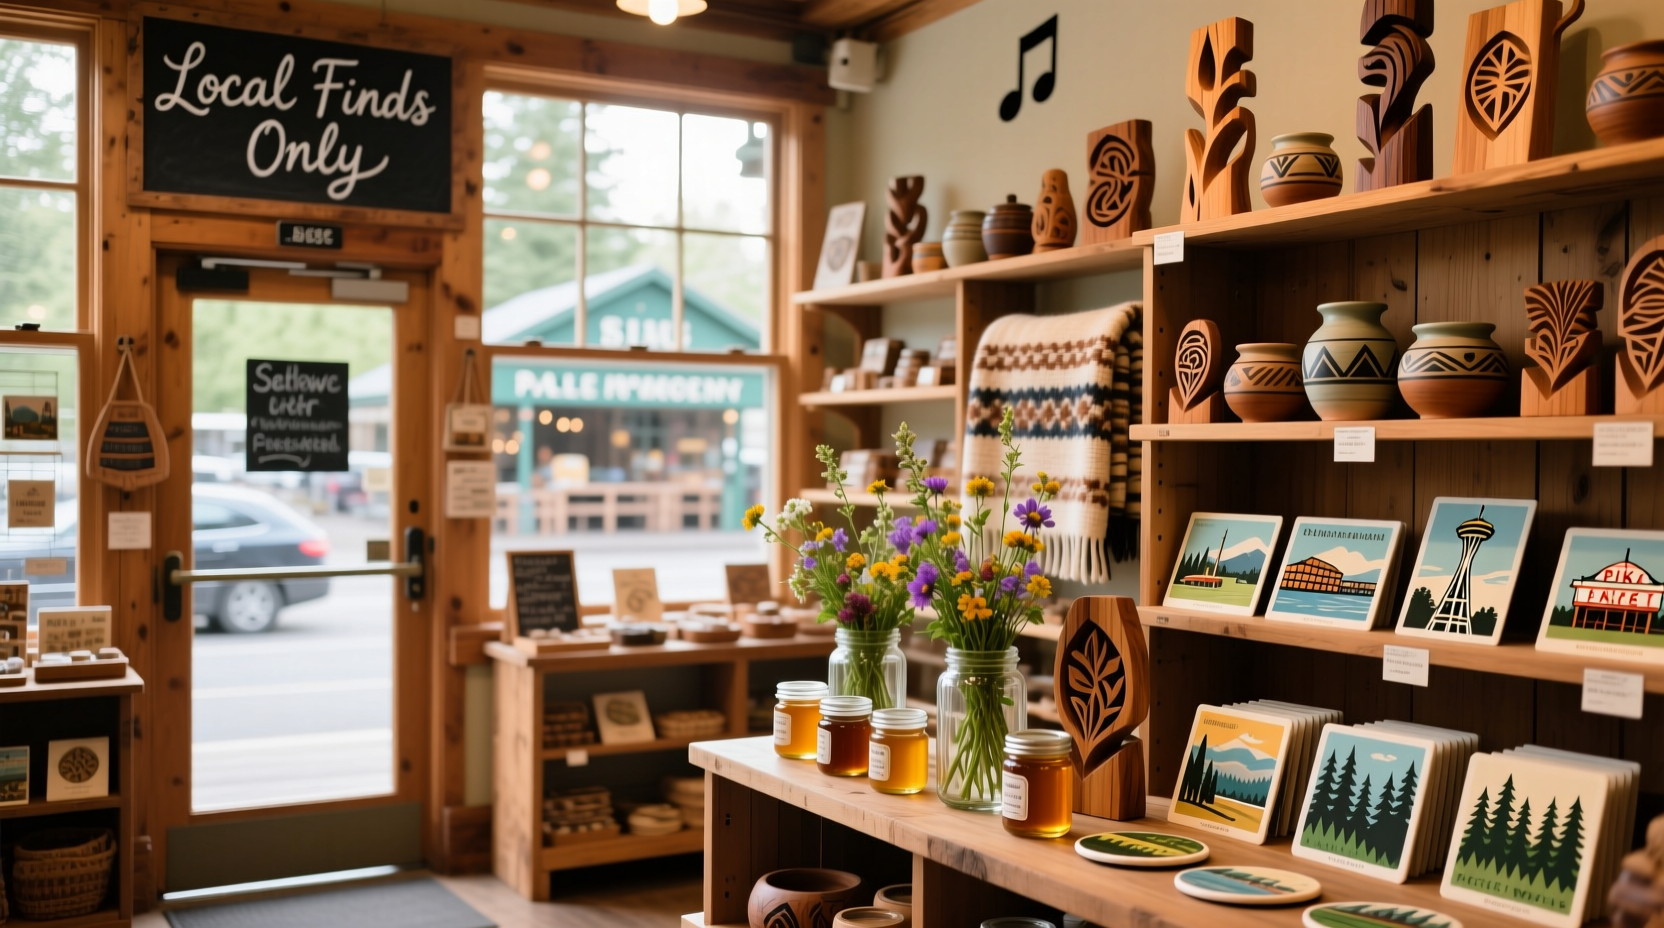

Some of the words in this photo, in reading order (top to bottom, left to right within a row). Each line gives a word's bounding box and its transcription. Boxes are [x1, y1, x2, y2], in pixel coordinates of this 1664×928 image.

[155, 42, 298, 117] Local
[312, 58, 437, 127] Finds
[246, 119, 390, 200] Only
